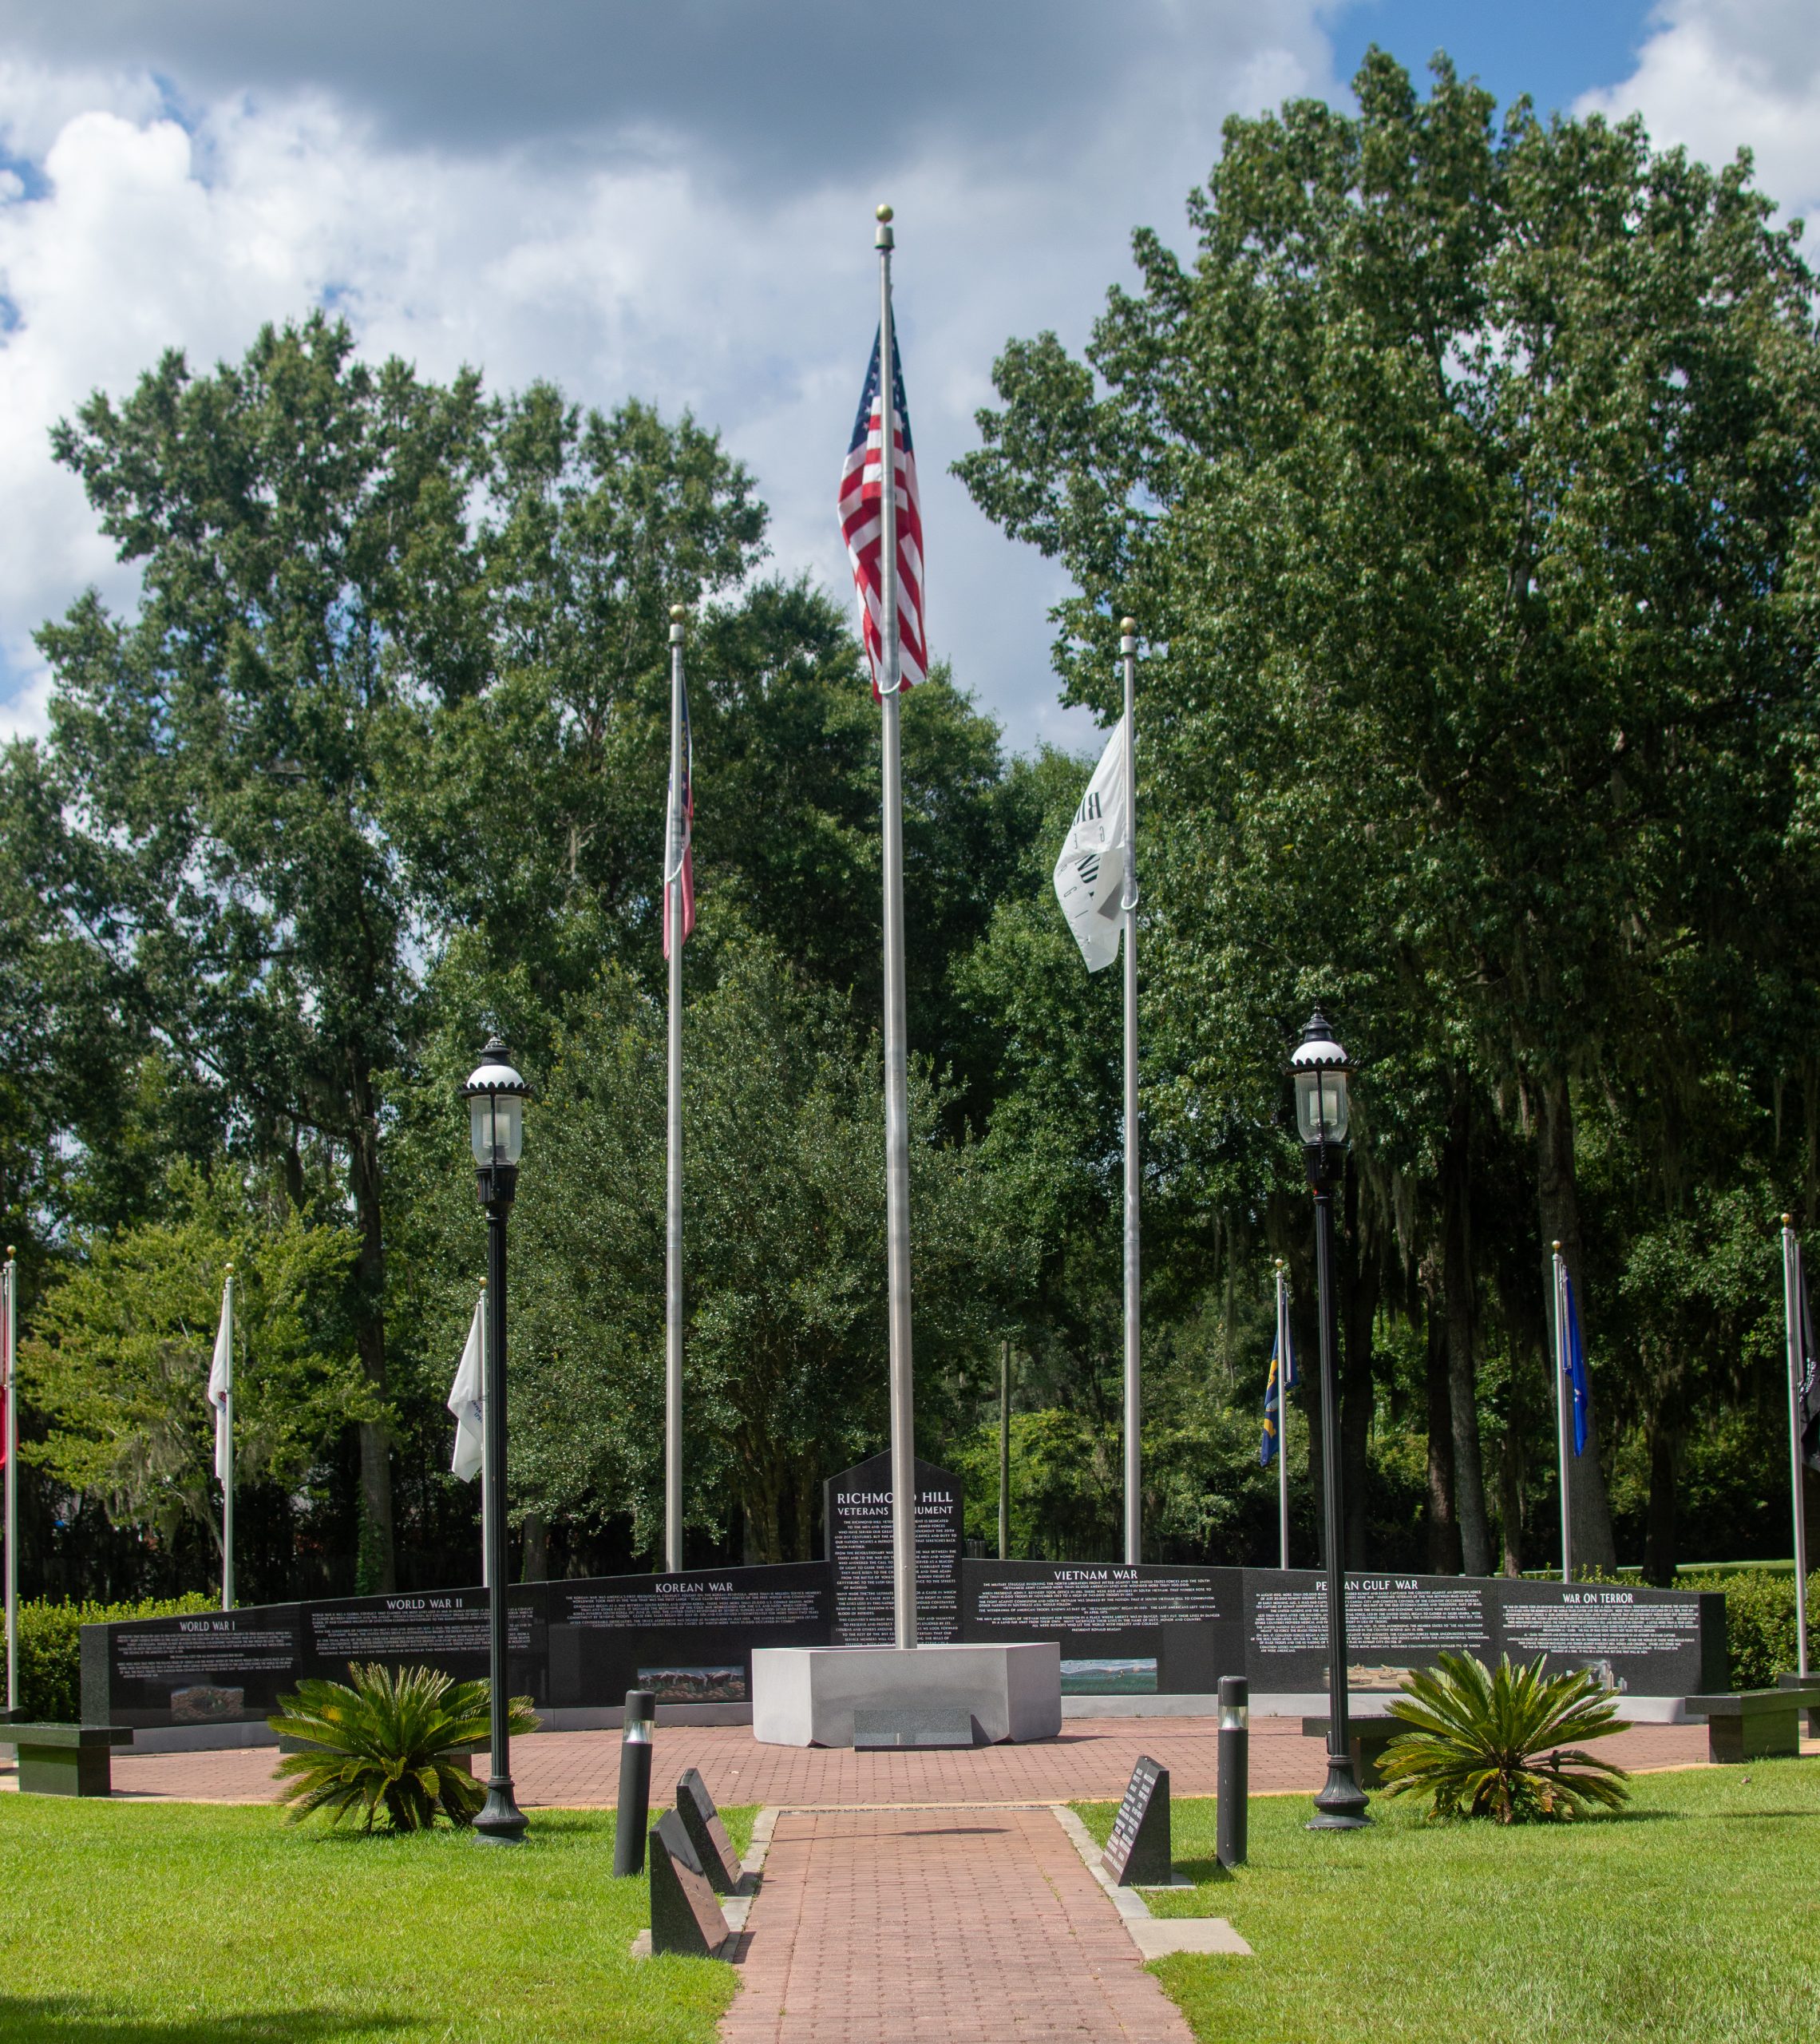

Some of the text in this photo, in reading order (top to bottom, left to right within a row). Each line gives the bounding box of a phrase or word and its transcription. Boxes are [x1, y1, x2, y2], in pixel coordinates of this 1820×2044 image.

[837, 1491, 953, 1504] RICHMO HILL
[837, 1506, 953, 1515] VETERANS UMENT
[1054, 1570, 1138, 1580] VIETNAM WAR
[655, 1582, 734, 1593] KOREAN WAR
[1316, 1580, 1418, 1590] PEAN GULF WAR
[1563, 1593, 1633, 1603] WAR ON TERROR
[386, 1598, 462, 1610] WORLD WAR II
[180, 1621, 235, 1632] WORLD WAR I
